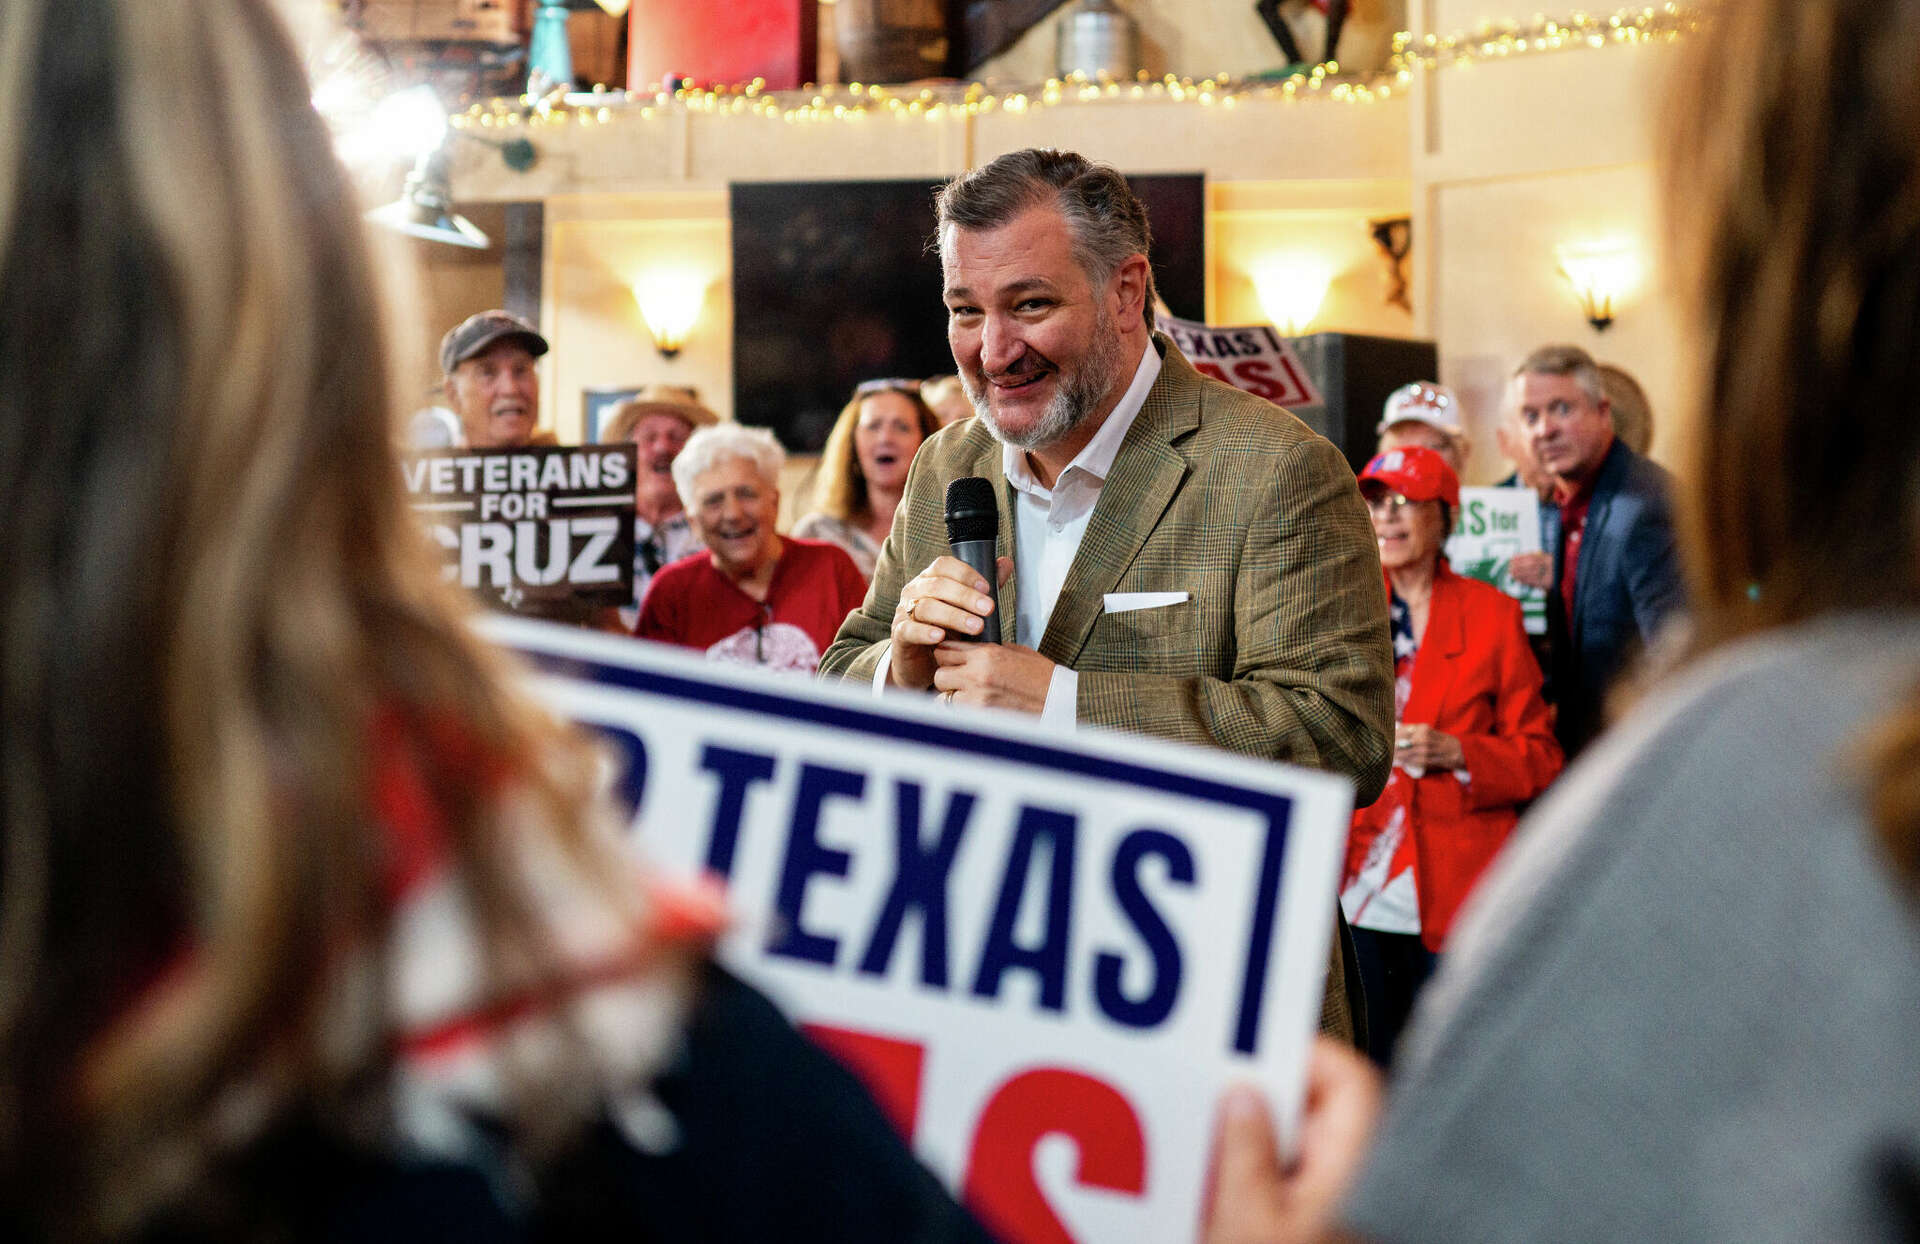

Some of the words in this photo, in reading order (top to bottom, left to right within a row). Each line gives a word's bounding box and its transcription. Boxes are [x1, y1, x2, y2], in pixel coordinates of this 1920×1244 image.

[1158, 321, 1262, 357] EXAS
[402, 453, 628, 494] VETERANS
[481, 492, 548, 521] FOR
[1491, 509, 1519, 531] for
[697, 744, 1199, 1031] TEXAS
